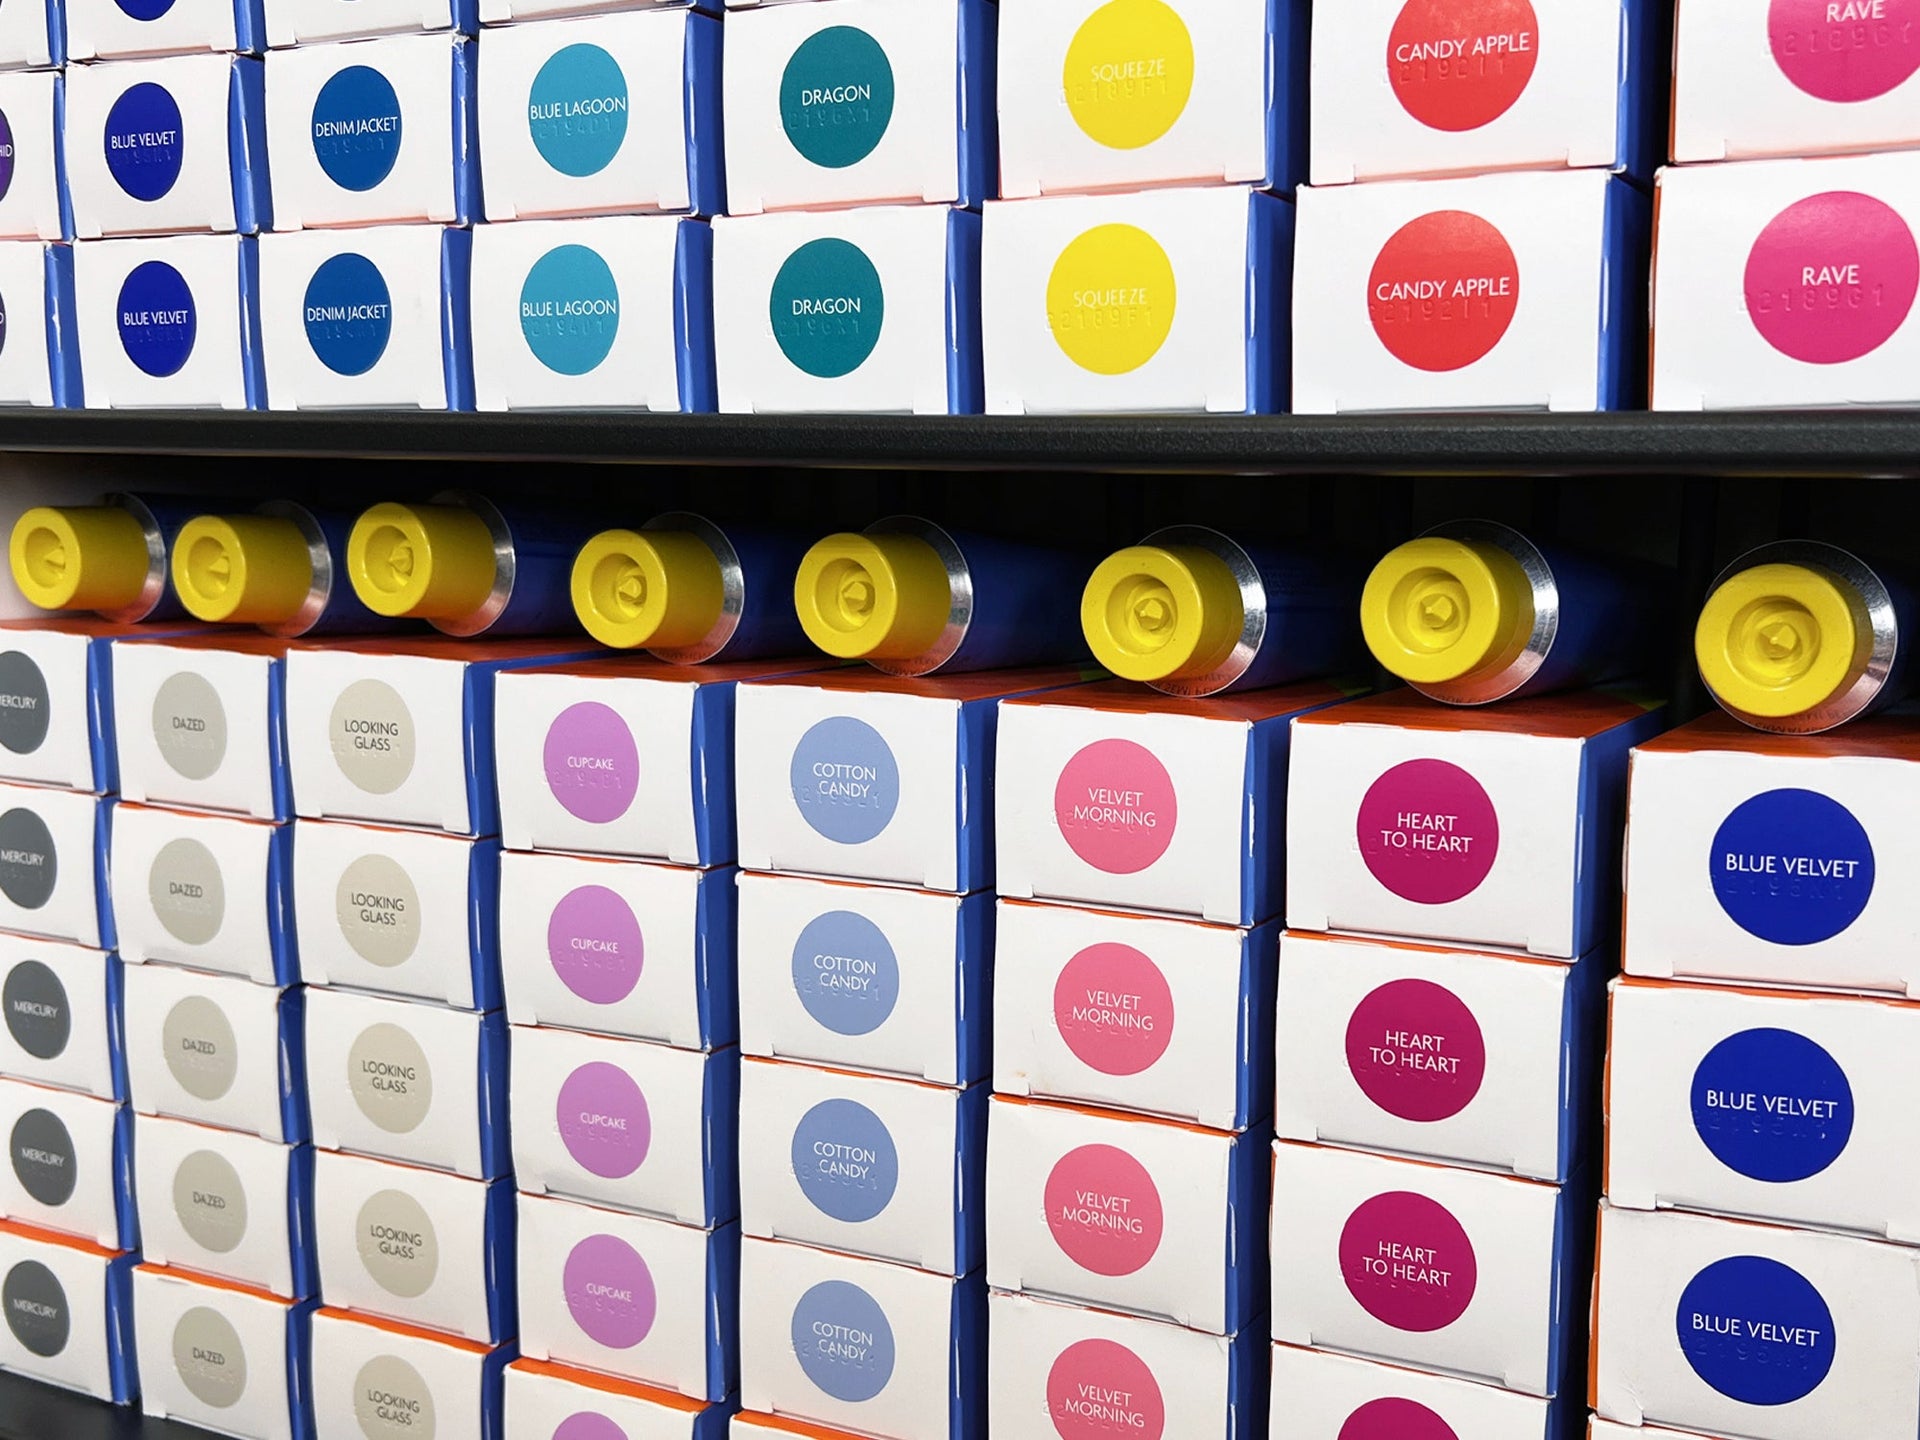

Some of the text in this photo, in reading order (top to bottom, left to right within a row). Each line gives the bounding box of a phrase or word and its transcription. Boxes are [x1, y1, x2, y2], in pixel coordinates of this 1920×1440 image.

[1826, 0, 1886, 23] RAVE
[1396, 32, 1530, 63] CANDY APPLE
[1091, 58, 1165, 83] SQUEEZE
[802, 84, 870, 106] DRAGON
[530, 97, 626, 120] BLUE LAGOON
[315, 116, 398, 137] DENIM JACKET
[111, 130, 176, 149] BLUE VELVET
[1802, 265, 1860, 286] RAVE
[1073, 287, 1147, 308] SQUEEZE
[1376, 277, 1510, 301] CANDY APPLE
[307, 304, 388, 322] DENIM JACKET
[522, 299, 617, 317] BLUE LAGOON
[792, 297, 861, 315] DRAGON
[124, 310, 188, 326] BLUE VELVET
[0, 694, 37, 710] ERCURY
[172, 716, 205, 732] DAZED
[344, 719, 399, 737] LOOKING
[354, 736, 391, 752] GLASS
[567, 756, 614, 770] CUPCAKE
[813, 762, 877, 781] COTTON
[819, 780, 871, 798] CANDY
[1088, 787, 1144, 807] VELVET
[1073, 805, 1156, 827] MORNING
[1397, 811, 1458, 832] HEART
[1381, 830, 1407, 848] TO
[1412, 833, 1473, 853] HEART
[1, 849, 45, 866] MERCURY
[1725, 853, 1859, 878] BLUE VELVET
[169, 882, 203, 898] DAZED
[351, 892, 405, 912] LOOKING
[360, 909, 396, 926] GLASS
[571, 937, 619, 954] CUPCAKE
[813, 954, 877, 975] COTTON
[819, 972, 871, 991] CANDY
[14, 1001, 59, 1019] MERCURY
[1086, 989, 1141, 1011] VELVET
[1072, 1006, 1154, 1031] MORNING
[182, 1038, 216, 1055] DAZED
[1385, 1030, 1445, 1052] HEART
[362, 1060, 416, 1080] LOOKING
[1369, 1047, 1396, 1066] TO
[1401, 1052, 1461, 1074] HEART
[372, 1076, 407, 1094] GLASS
[1706, 1089, 1838, 1119] BLUE VELVET
[580, 1112, 627, 1130] CUPCAKE
[21, 1147, 65, 1168] MERCURY
[813, 1141, 876, 1164] COTTON
[819, 1159, 870, 1180] CANDY
[192, 1191, 226, 1209] DAZED
[1075, 1190, 1131, 1213] VELVET
[1062, 1206, 1143, 1234] MORNING
[370, 1224, 422, 1246] LOOKING
[379, 1241, 415, 1259] GLASS
[1378, 1240, 1437, 1265] HEART
[1362, 1256, 1388, 1276] TO
[1393, 1263, 1451, 1287] HEART
[586, 1282, 632, 1302] CUPCAKE
[13, 1298, 58, 1320] MERCURY
[812, 1321, 873, 1346] COTTON
[1692, 1313, 1820, 1347] BLUE VELVET
[192, 1348, 225, 1366] DAZED
[818, 1338, 868, 1361] CANDY
[367, 1390, 420, 1414] LOOKING
[1078, 1383, 1133, 1407] VELVET
[376, 1407, 413, 1426] GLASS
[1064, 1398, 1145, 1427] MORNING
